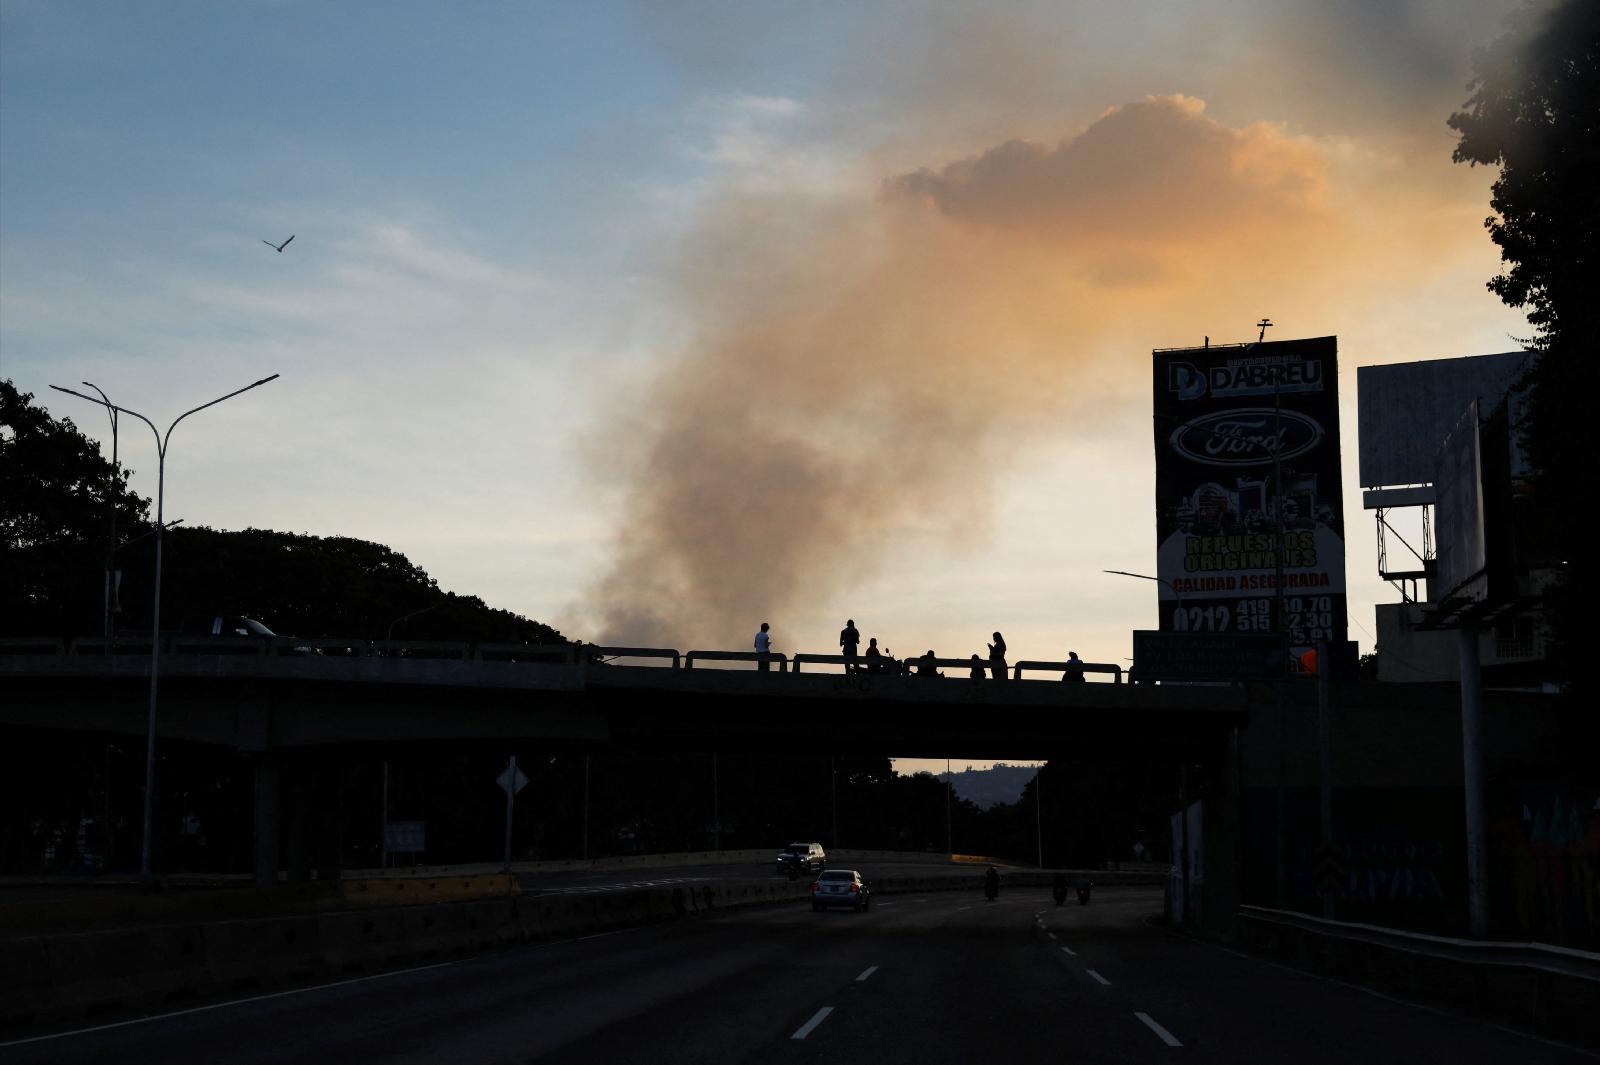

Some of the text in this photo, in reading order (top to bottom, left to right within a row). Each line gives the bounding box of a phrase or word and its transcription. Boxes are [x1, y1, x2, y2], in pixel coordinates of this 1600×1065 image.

[1205, 420, 1288, 454] Ford
[1184, 548, 1317, 572] ORIGINALES
[1172, 572, 1330, 592] CALIDAD ASEGURADA
[1284, 596, 1332, 613] 0.70
[1173, 605, 1230, 632] 0212
[1286, 612, 1332, 629] 2.30
